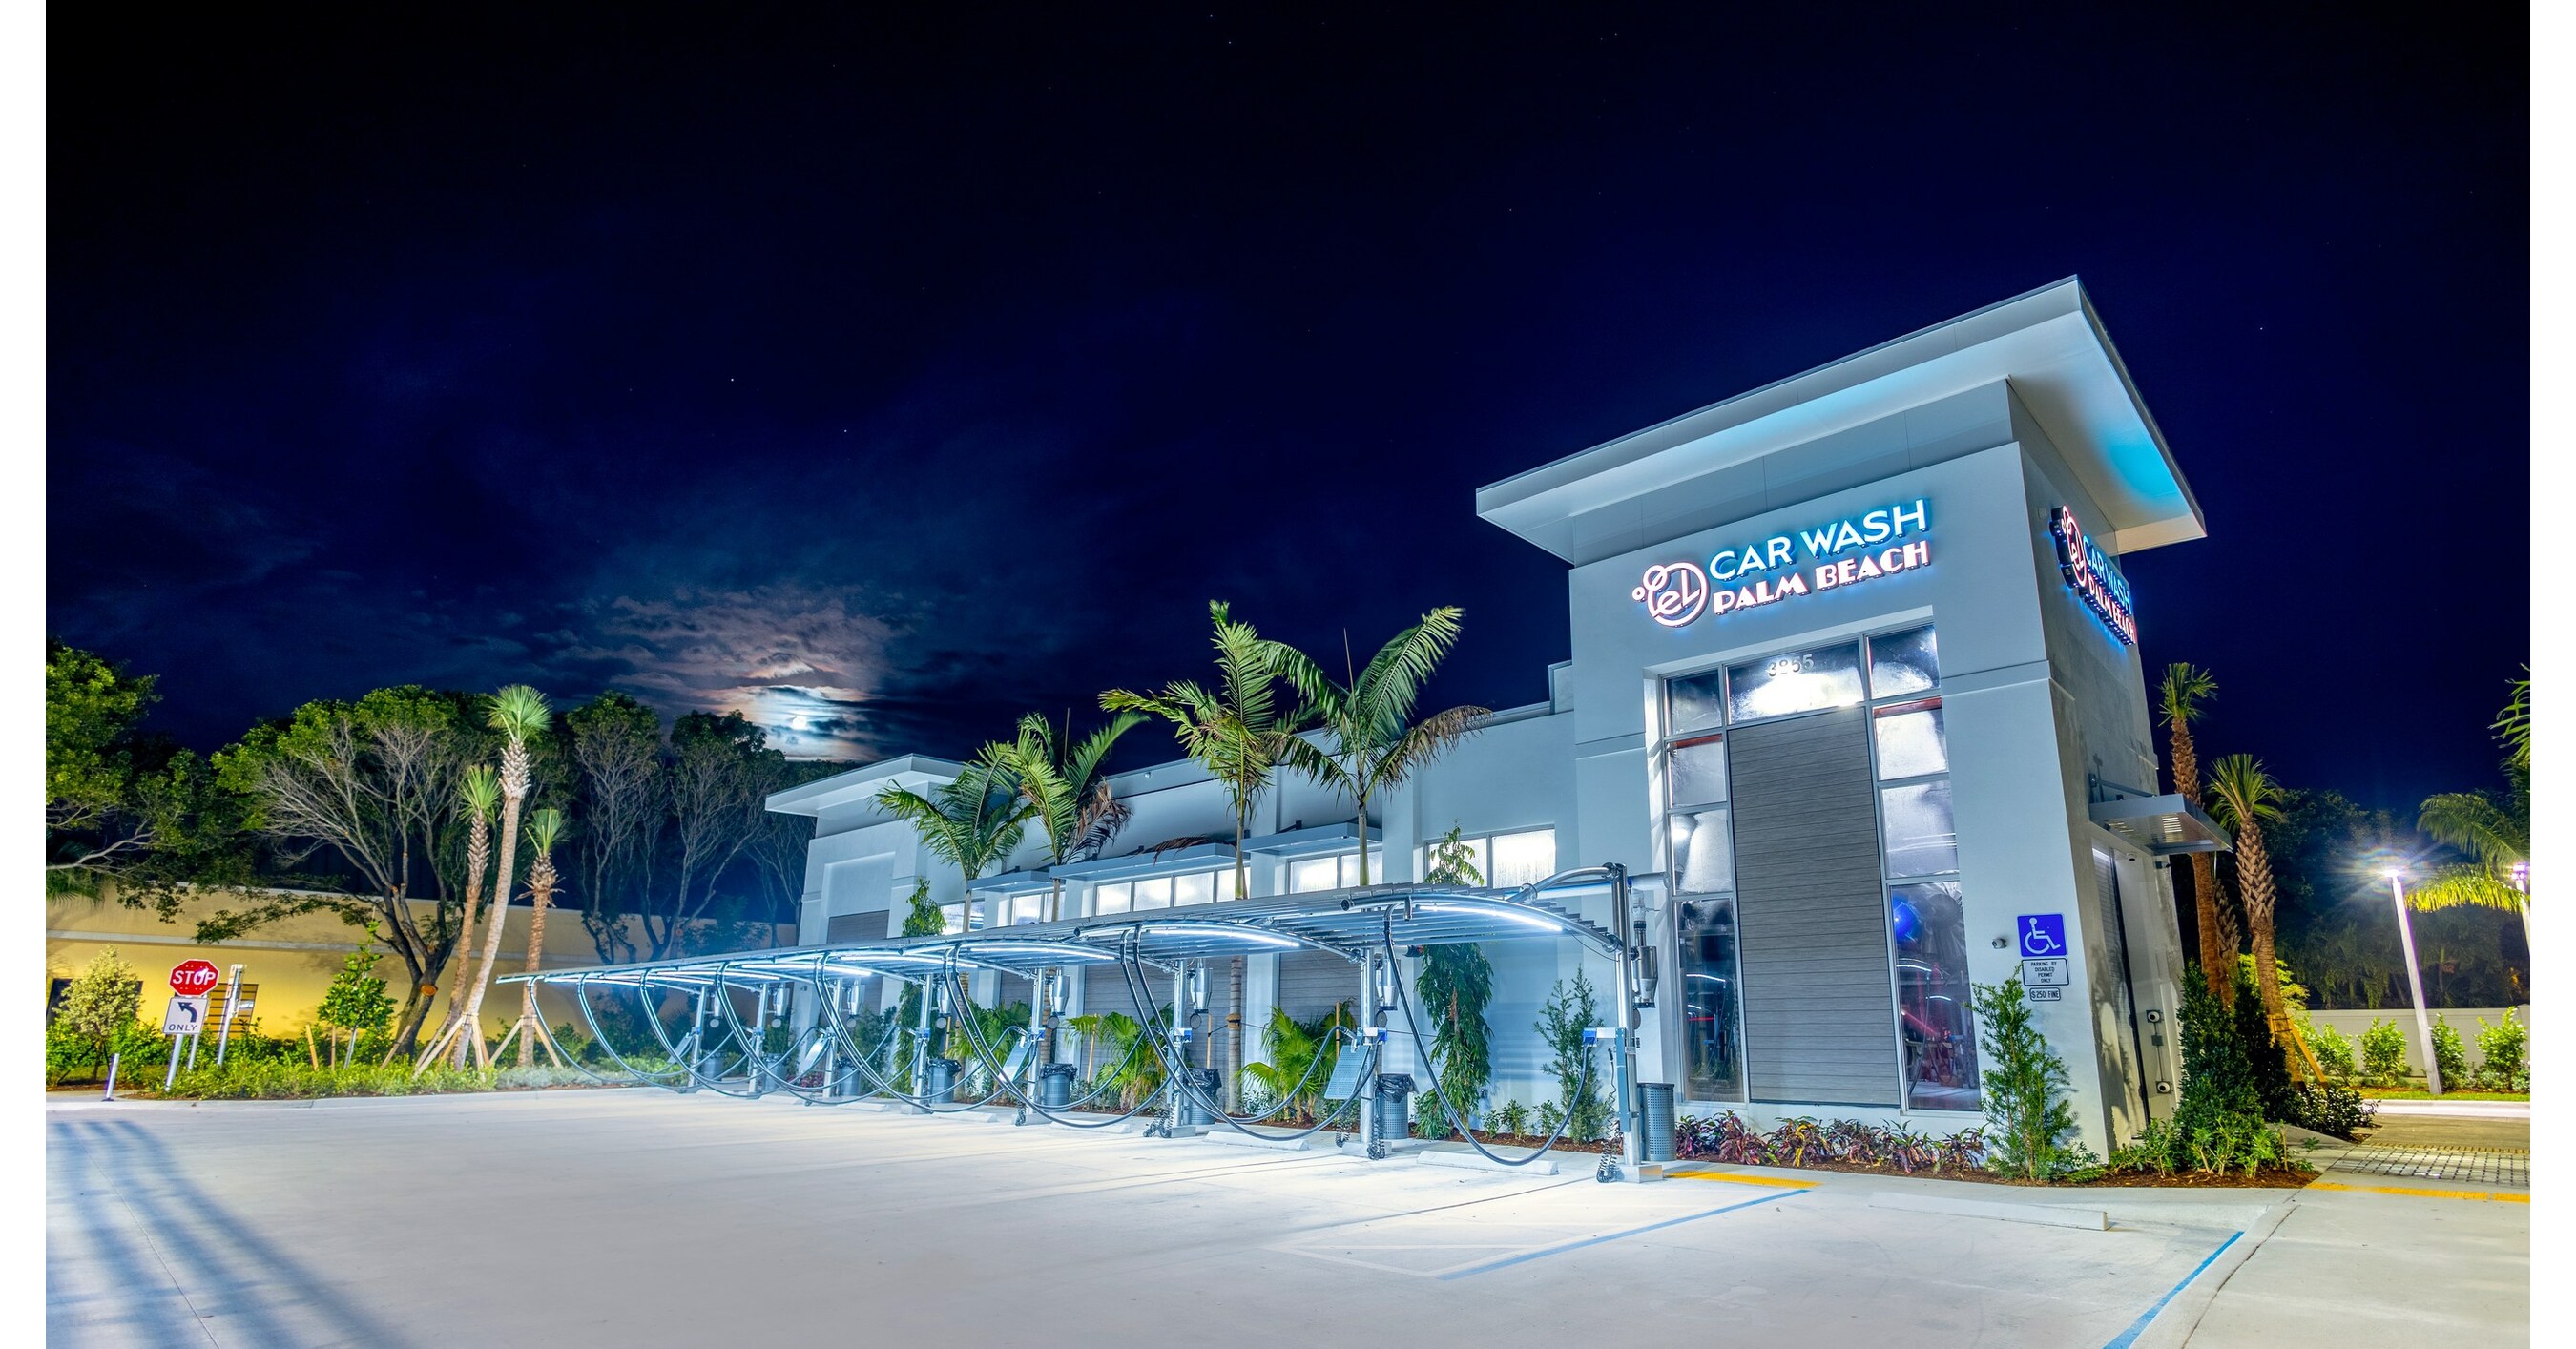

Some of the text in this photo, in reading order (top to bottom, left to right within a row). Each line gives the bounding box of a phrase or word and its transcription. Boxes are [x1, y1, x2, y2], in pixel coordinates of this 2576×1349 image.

[1709, 498, 1929, 581] CAR WASH
[1713, 540, 1930, 614] PALM BEACH
[2083, 535, 2132, 615] CAR WASH
[2088, 573, 2113, 618] PALM
[1767, 654, 1815, 677] 3855
[172, 970, 217, 986] STOP
[168, 1023, 197, 1032] ONLY
